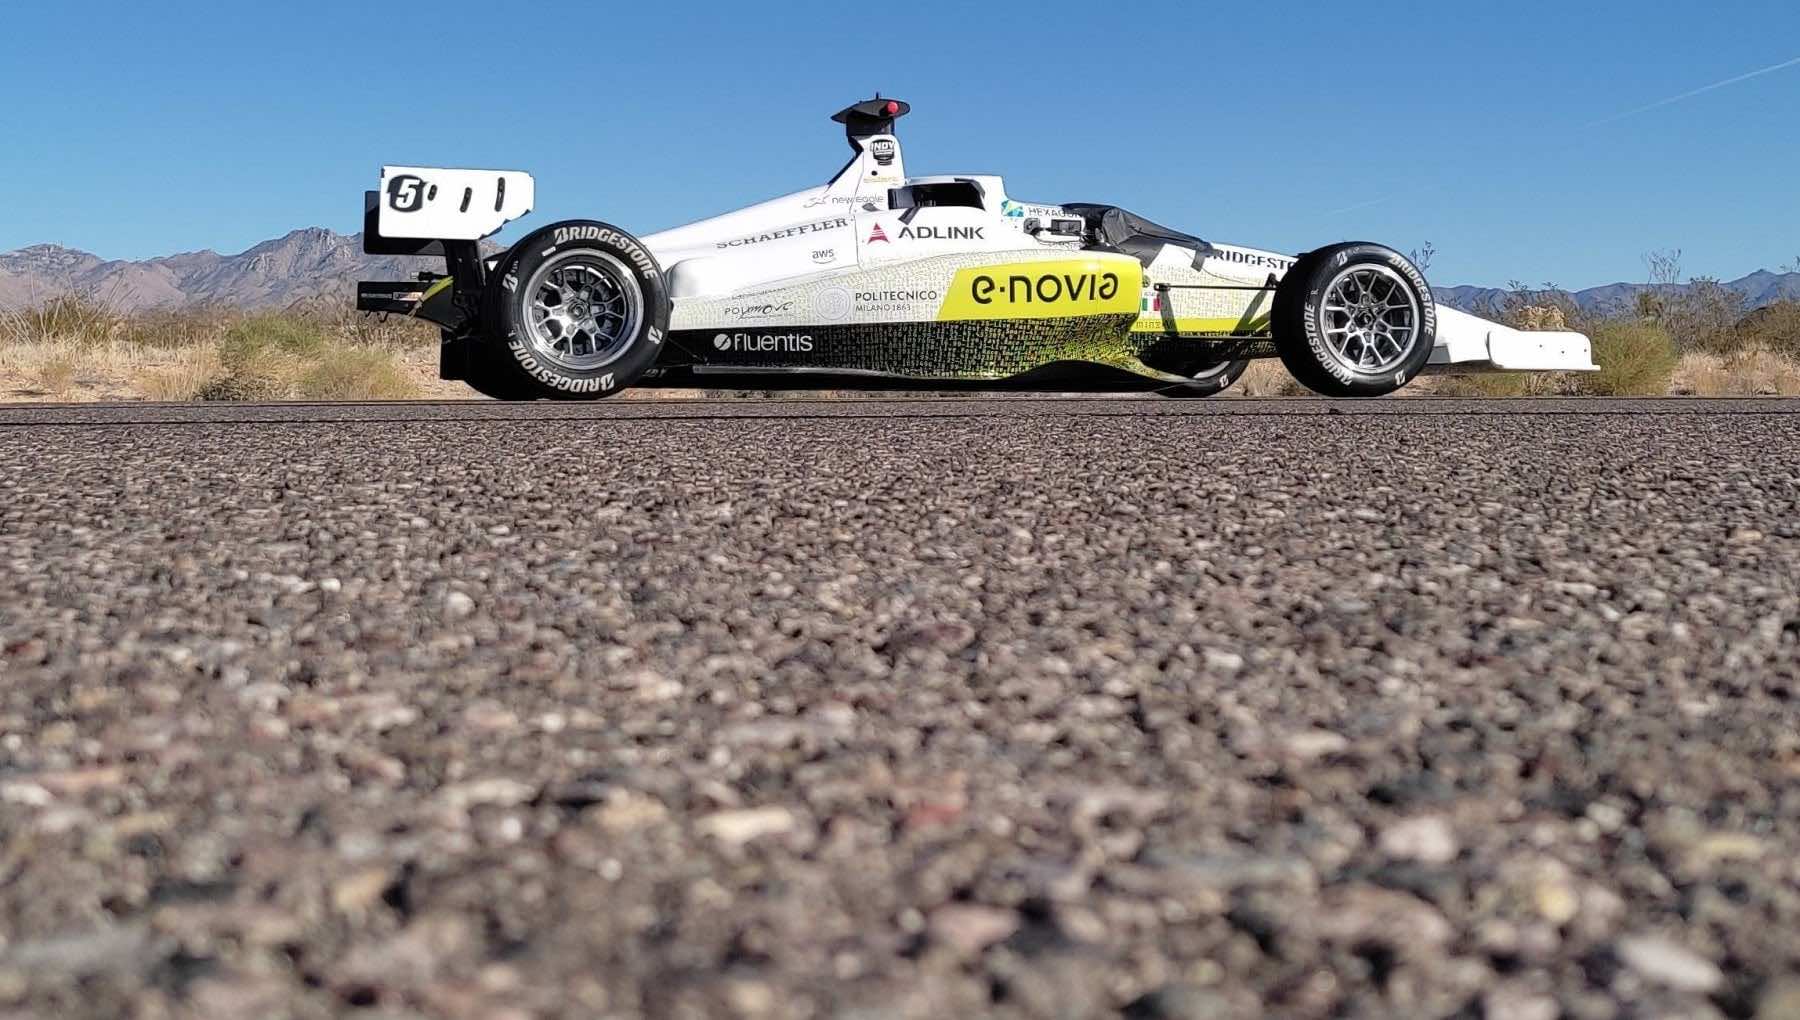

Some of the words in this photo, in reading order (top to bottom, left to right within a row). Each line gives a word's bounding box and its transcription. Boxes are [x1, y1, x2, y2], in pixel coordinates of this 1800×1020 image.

[869, 141, 896, 151] INDY
[395, 178, 421, 209] 5
[716, 217, 848, 249] SCHAEFFLER
[898, 226, 985, 240] ADLINK
[554, 226, 658, 280] BRIDGESTONE
[812, 248, 834, 259] aws
[855, 290, 937, 301] POLITECNICO
[1387, 253, 1434, 337] BRIDGESTONE
[855, 303, 890, 312] MILANO
[734, 333, 813, 351] fluentis
[1304, 302, 1352, 386] BRIDGESTONE
[508, 340, 615, 393] BRIDGESTONE
